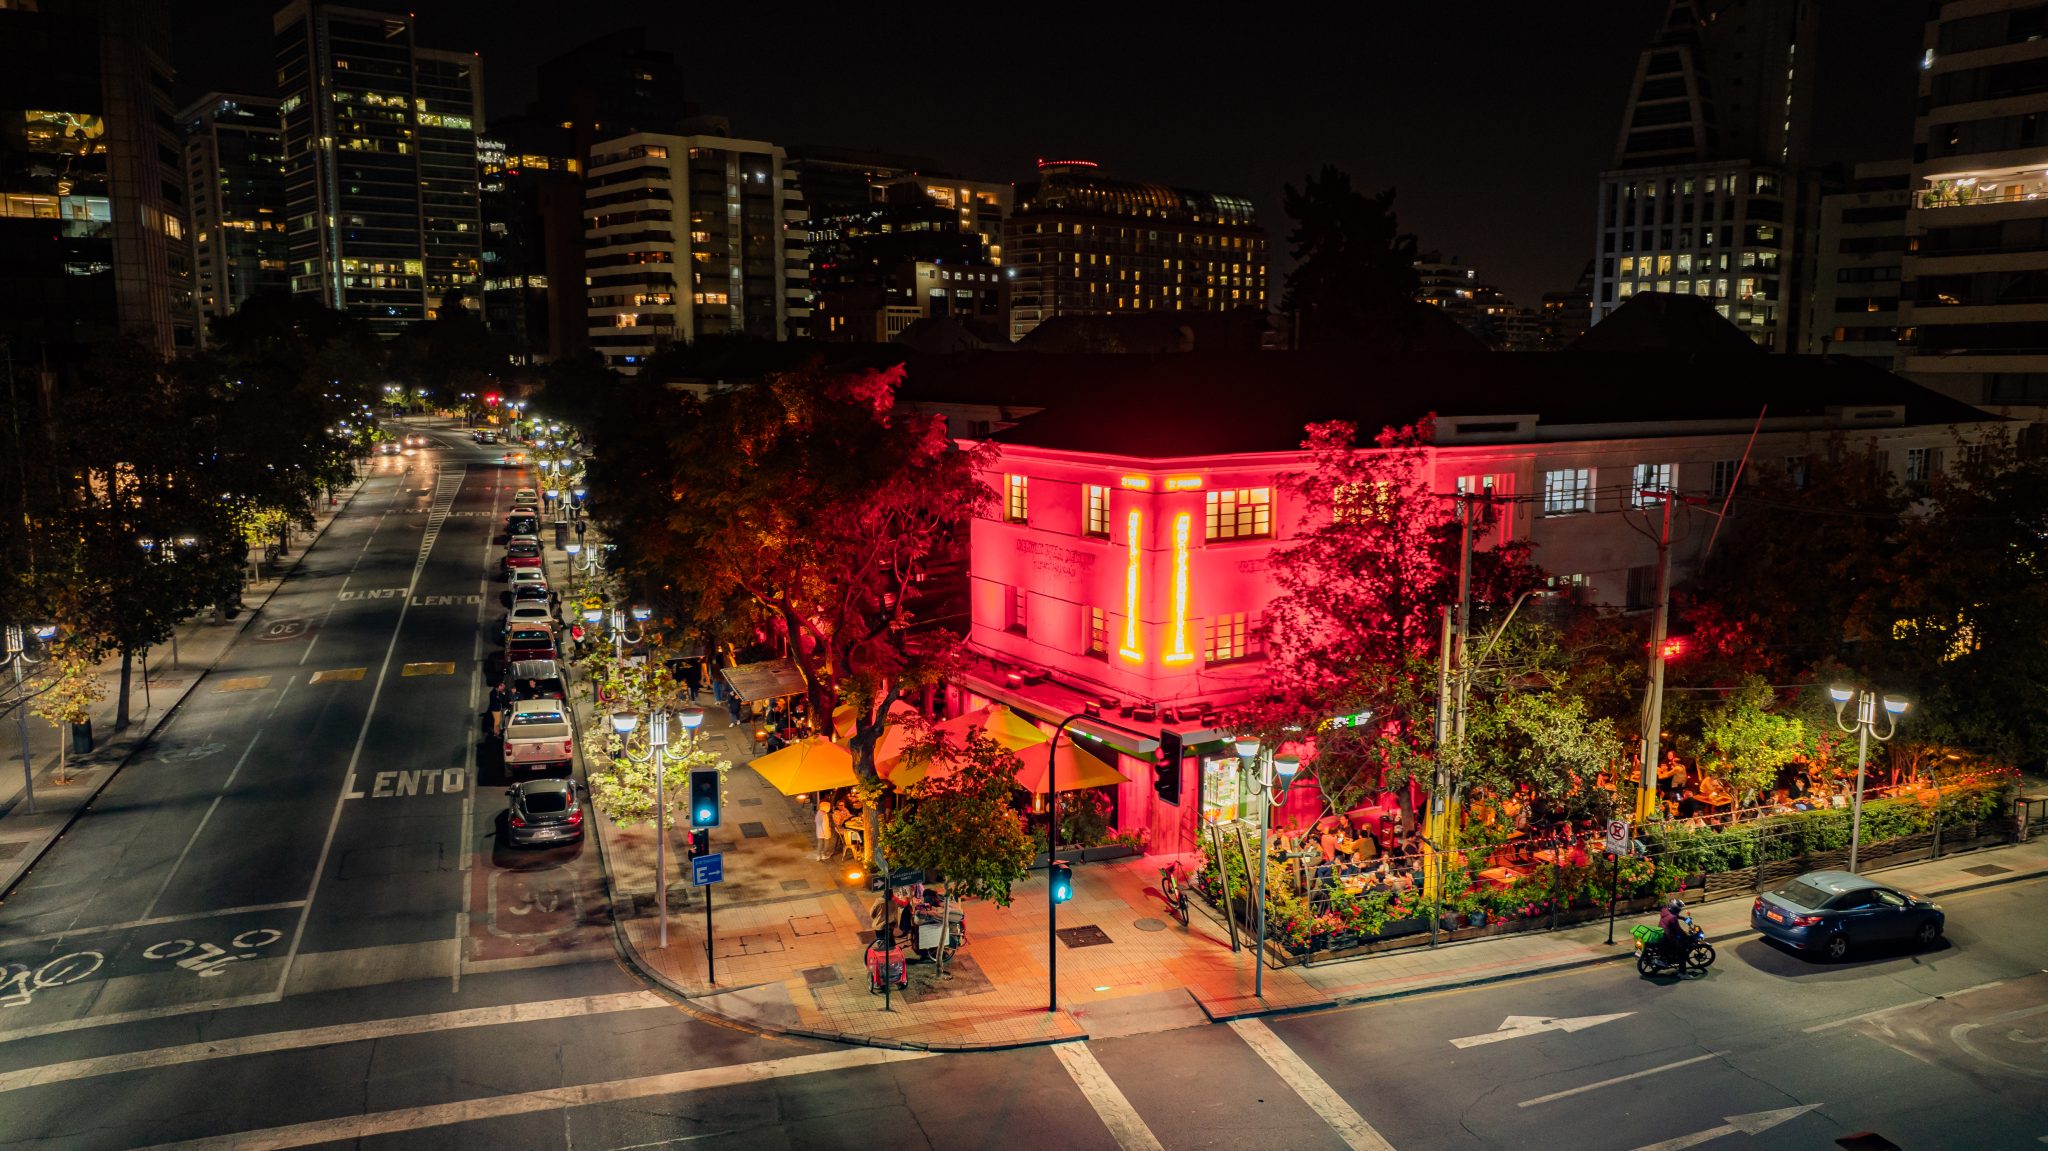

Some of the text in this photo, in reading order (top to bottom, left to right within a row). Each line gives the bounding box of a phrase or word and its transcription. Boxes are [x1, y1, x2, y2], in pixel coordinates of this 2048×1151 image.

[340, 588, 409, 601] LENTO
[411, 594, 480, 606] LENTO
[270, 623, 299, 635] 30
[344, 768, 464, 800] LENTO
[696, 866, 708, 884] E
